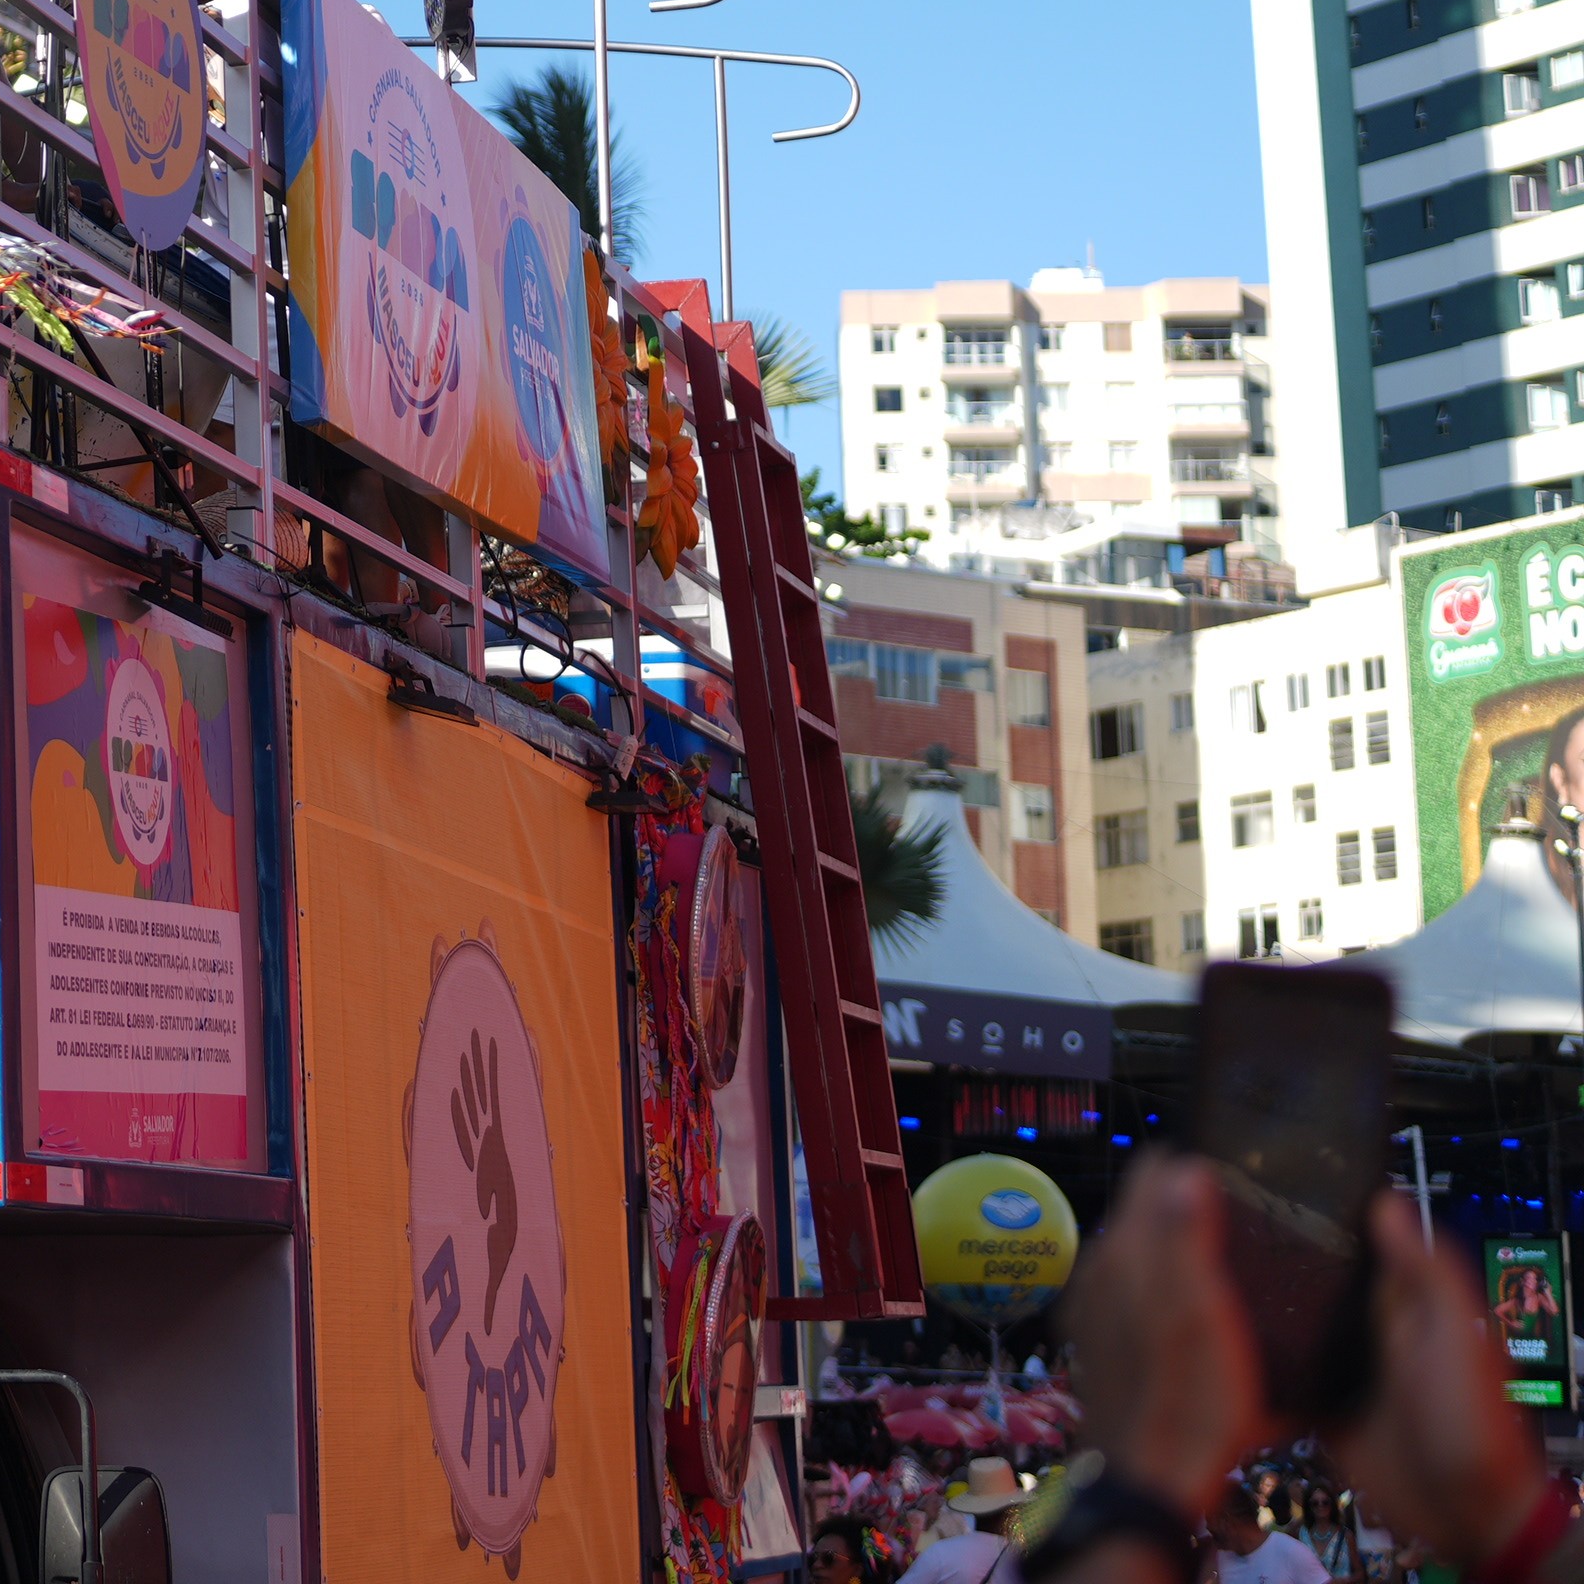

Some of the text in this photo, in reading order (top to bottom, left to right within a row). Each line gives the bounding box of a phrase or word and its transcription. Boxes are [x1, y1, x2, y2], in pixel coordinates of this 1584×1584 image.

[368, 67, 442, 179] CARNAVAL SALVADOR
[512, 323, 561, 389] SALVADOR
[1525, 550, 1553, 608] É
[62, 907, 68, 927] É
[69, 912, 105, 931] PROIBIDA
[108, 917, 114, 932] A
[114, 918, 139, 935] VENDA
[140, 920, 150, 937] DE
[151, 922, 180, 940] BEBIDAS
[48, 941, 106, 963] INDEPENDENTE
[107, 947, 117, 964] DE
[118, 949, 133, 966] SUA
[192, 957, 197, 972] A
[198, 958, 229, 977] CRIANÇAS
[229, 961, 234, 976] E
[50, 974, 109, 995] ADOLESCENTES
[110, 979, 149, 998] CONFORME
[150, 983, 184, 1001] PREVISTO
[184, 986, 194, 1002] NO
[225, 990, 234, 1005] DO
[50, 1007, 67, 1024] ART.
[68, 1009, 77, 1025] 81
[79, 1009, 92, 1026] LEI
[93, 1010, 125, 1028] FEDERAL
[160, 1015, 194, 1032] ESTATUTO
[204, 1017, 231, 1037] CRIANÇA
[232, 1020, 237, 1035] E
[946, 1017, 1084, 1057] SOHO
[56, 1040, 68, 1057] DO
[69, 1041, 123, 1059] ADOLESCENTE
[124, 1044, 129, 1060] E
[141, 1045, 154, 1062] LEI
[154, 1046, 190, 1062] MUNICIPAL
[143, 1115, 174, 1133] SALVADOR
[958, 1236, 1059, 1258] mercado
[983, 1259, 1040, 1280] pago
